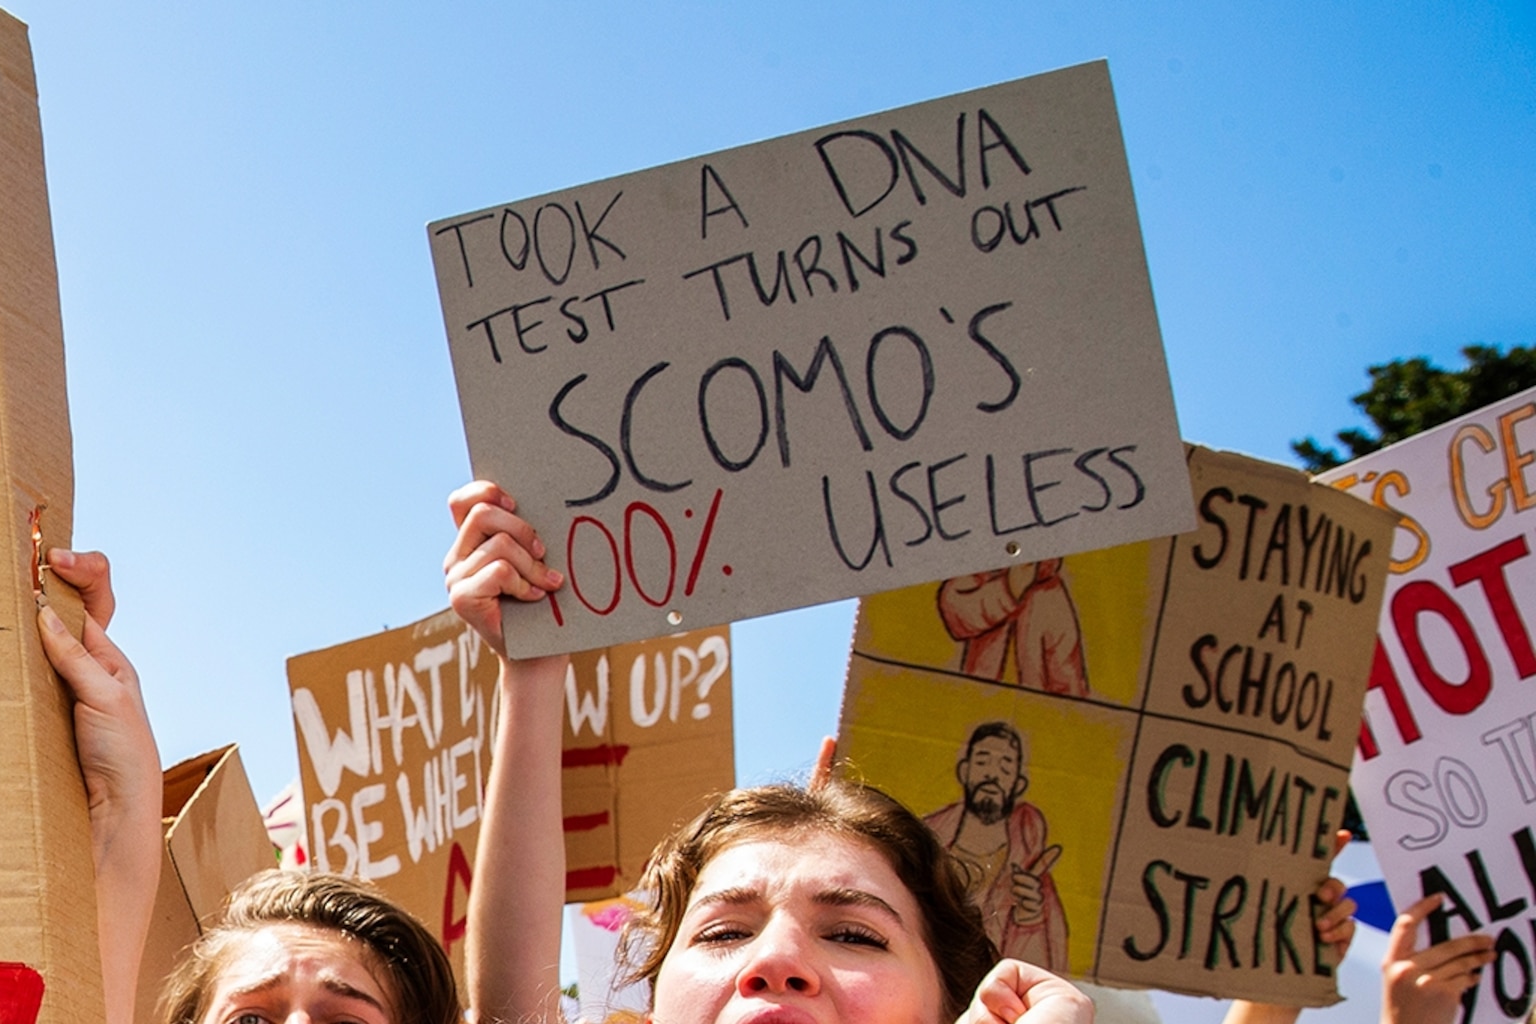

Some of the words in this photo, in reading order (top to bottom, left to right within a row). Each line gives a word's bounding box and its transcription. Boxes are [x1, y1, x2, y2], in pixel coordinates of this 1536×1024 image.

[436, 191, 627, 288] TOOK
[701, 164, 749, 239] A
[815, 108, 1031, 218] DNA
[467, 279, 645, 363] TEST
[683, 221, 917, 320] TURNS
[550, 302, 1021, 509] SCOMO'S
[823, 446, 1145, 571] USELESS
[1192, 487, 1372, 604] STAYING
[1330, 469, 1431, 575] 'S
[1258, 594, 1313, 650] AT
[292, 640, 454, 797] WHAT
[1182, 634, 1333, 741] SCHOOL
[312, 783, 401, 882] BE
[630, 635, 729, 728] UP?
[1147, 743, 1339, 859] CLIMATE
[1385, 756, 1488, 851] SO
[1123, 859, 1332, 977] STRIKE
